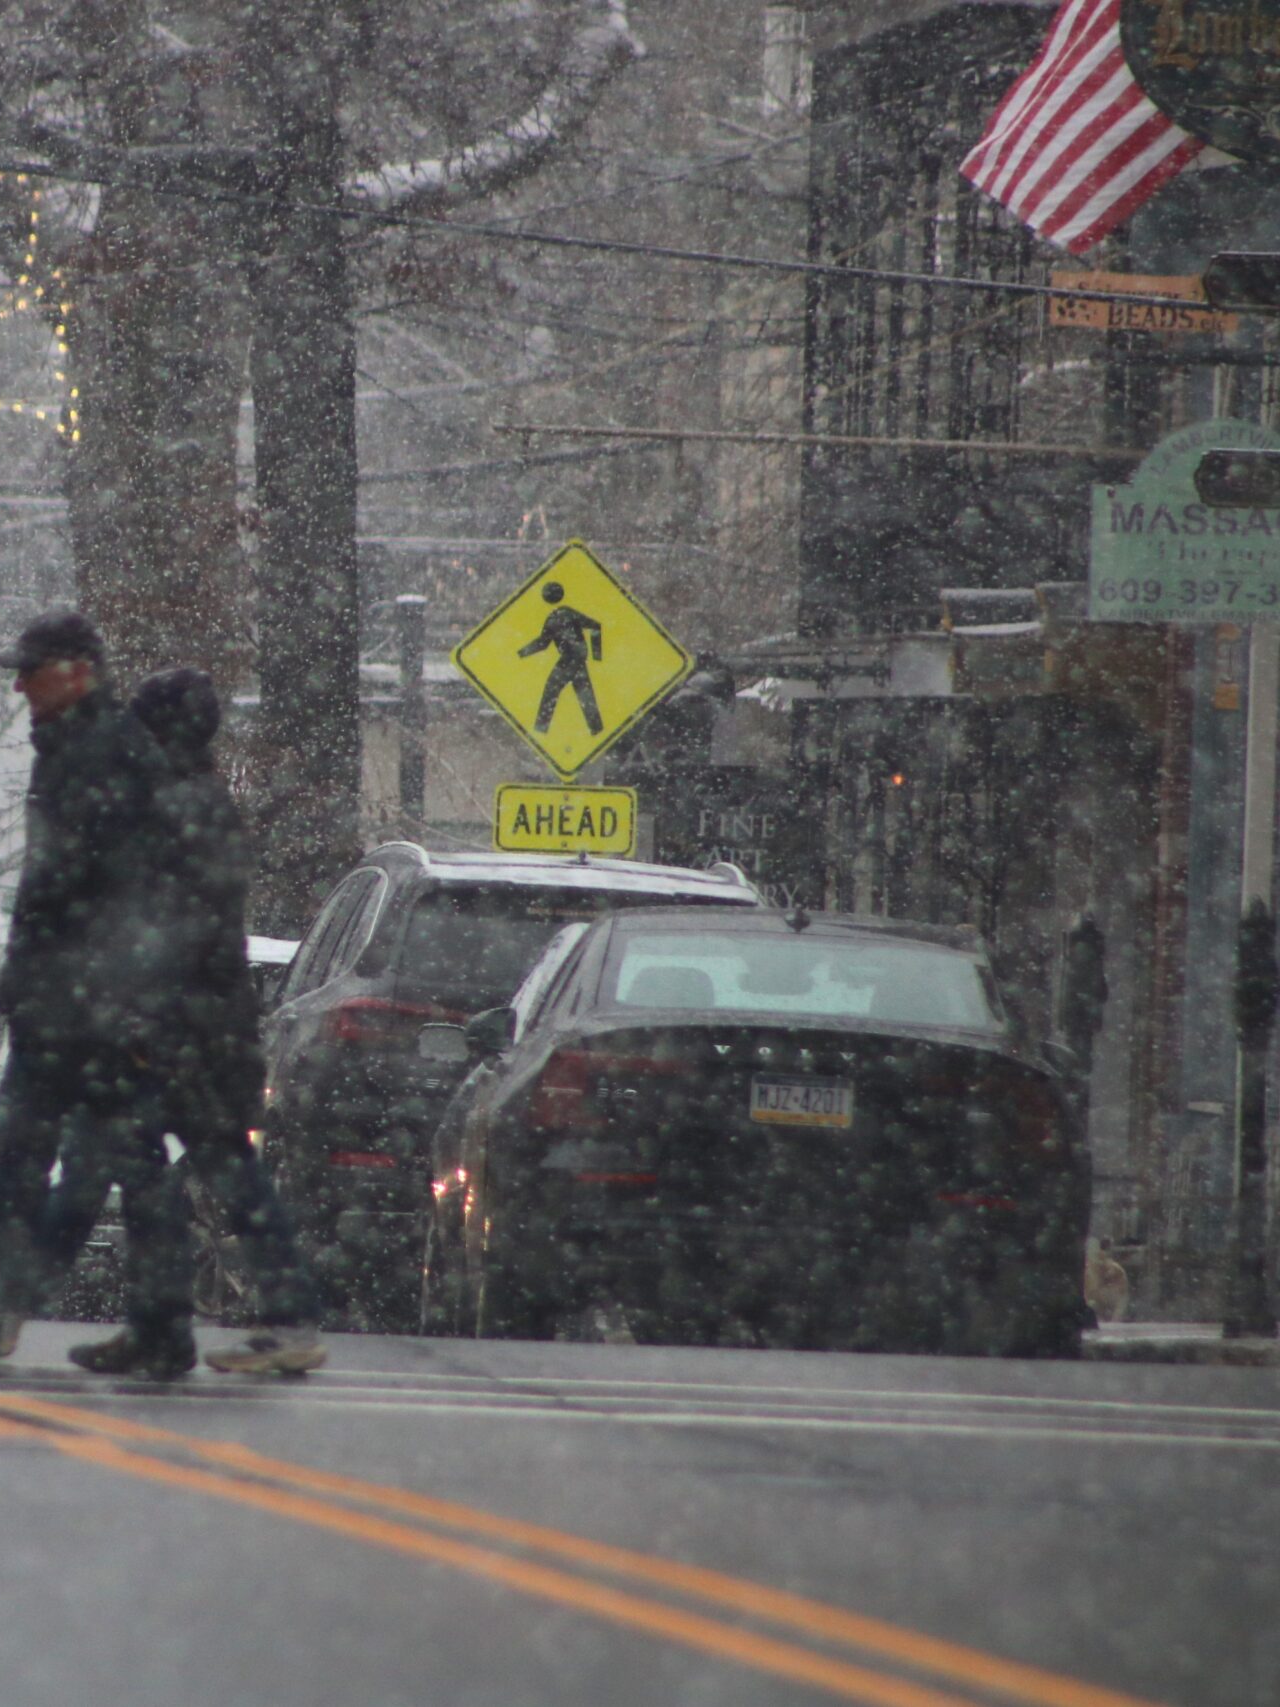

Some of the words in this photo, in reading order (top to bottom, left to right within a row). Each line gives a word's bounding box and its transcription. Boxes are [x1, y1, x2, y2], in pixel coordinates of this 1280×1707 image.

[1109, 502, 1280, 536] MASSA
[511, 803, 618, 838] AHEAD
[697, 808, 776, 838] FINE
